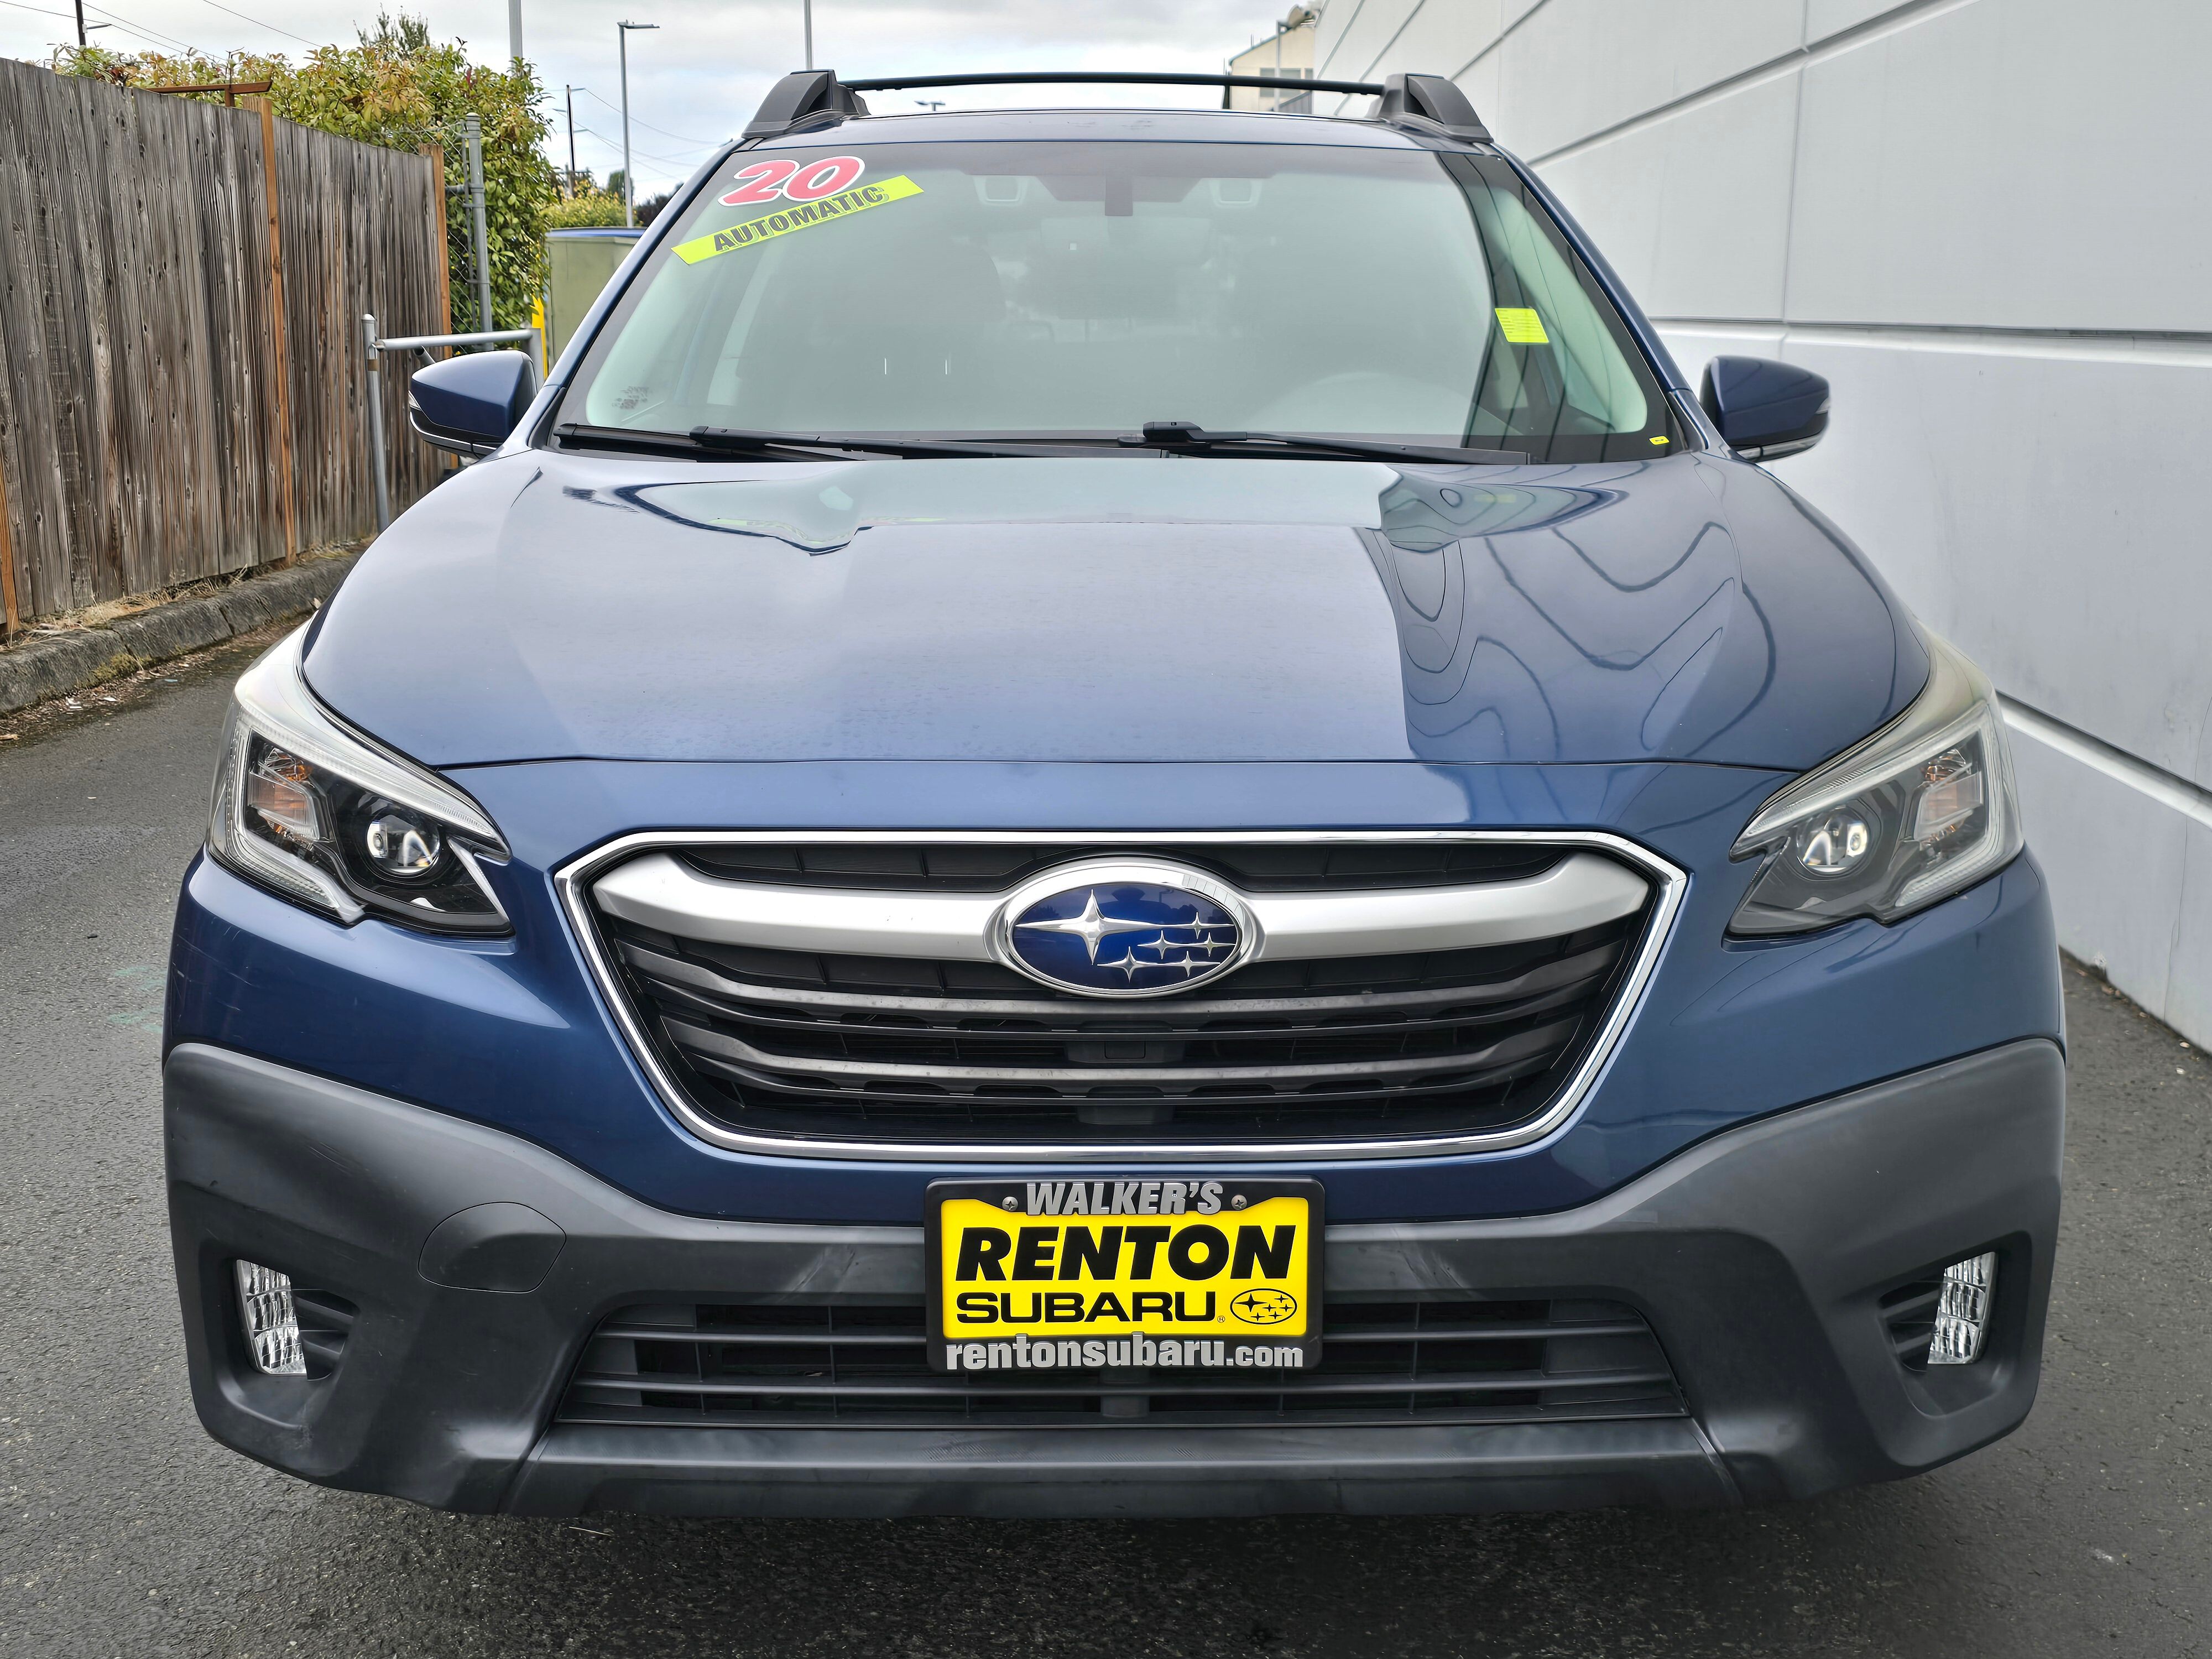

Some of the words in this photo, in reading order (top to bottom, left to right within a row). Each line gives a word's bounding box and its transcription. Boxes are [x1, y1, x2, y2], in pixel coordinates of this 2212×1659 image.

[718, 156, 865, 206] 20
[713, 186, 885, 252] AUTOMATIC
[1026, 1182, 1224, 1215] WALKER'S
[956, 1224, 1297, 1281] RENTON
[956, 1291, 1217, 1324] SUBARU
[946, 1332, 1303, 1371] rentonsubaru.com
